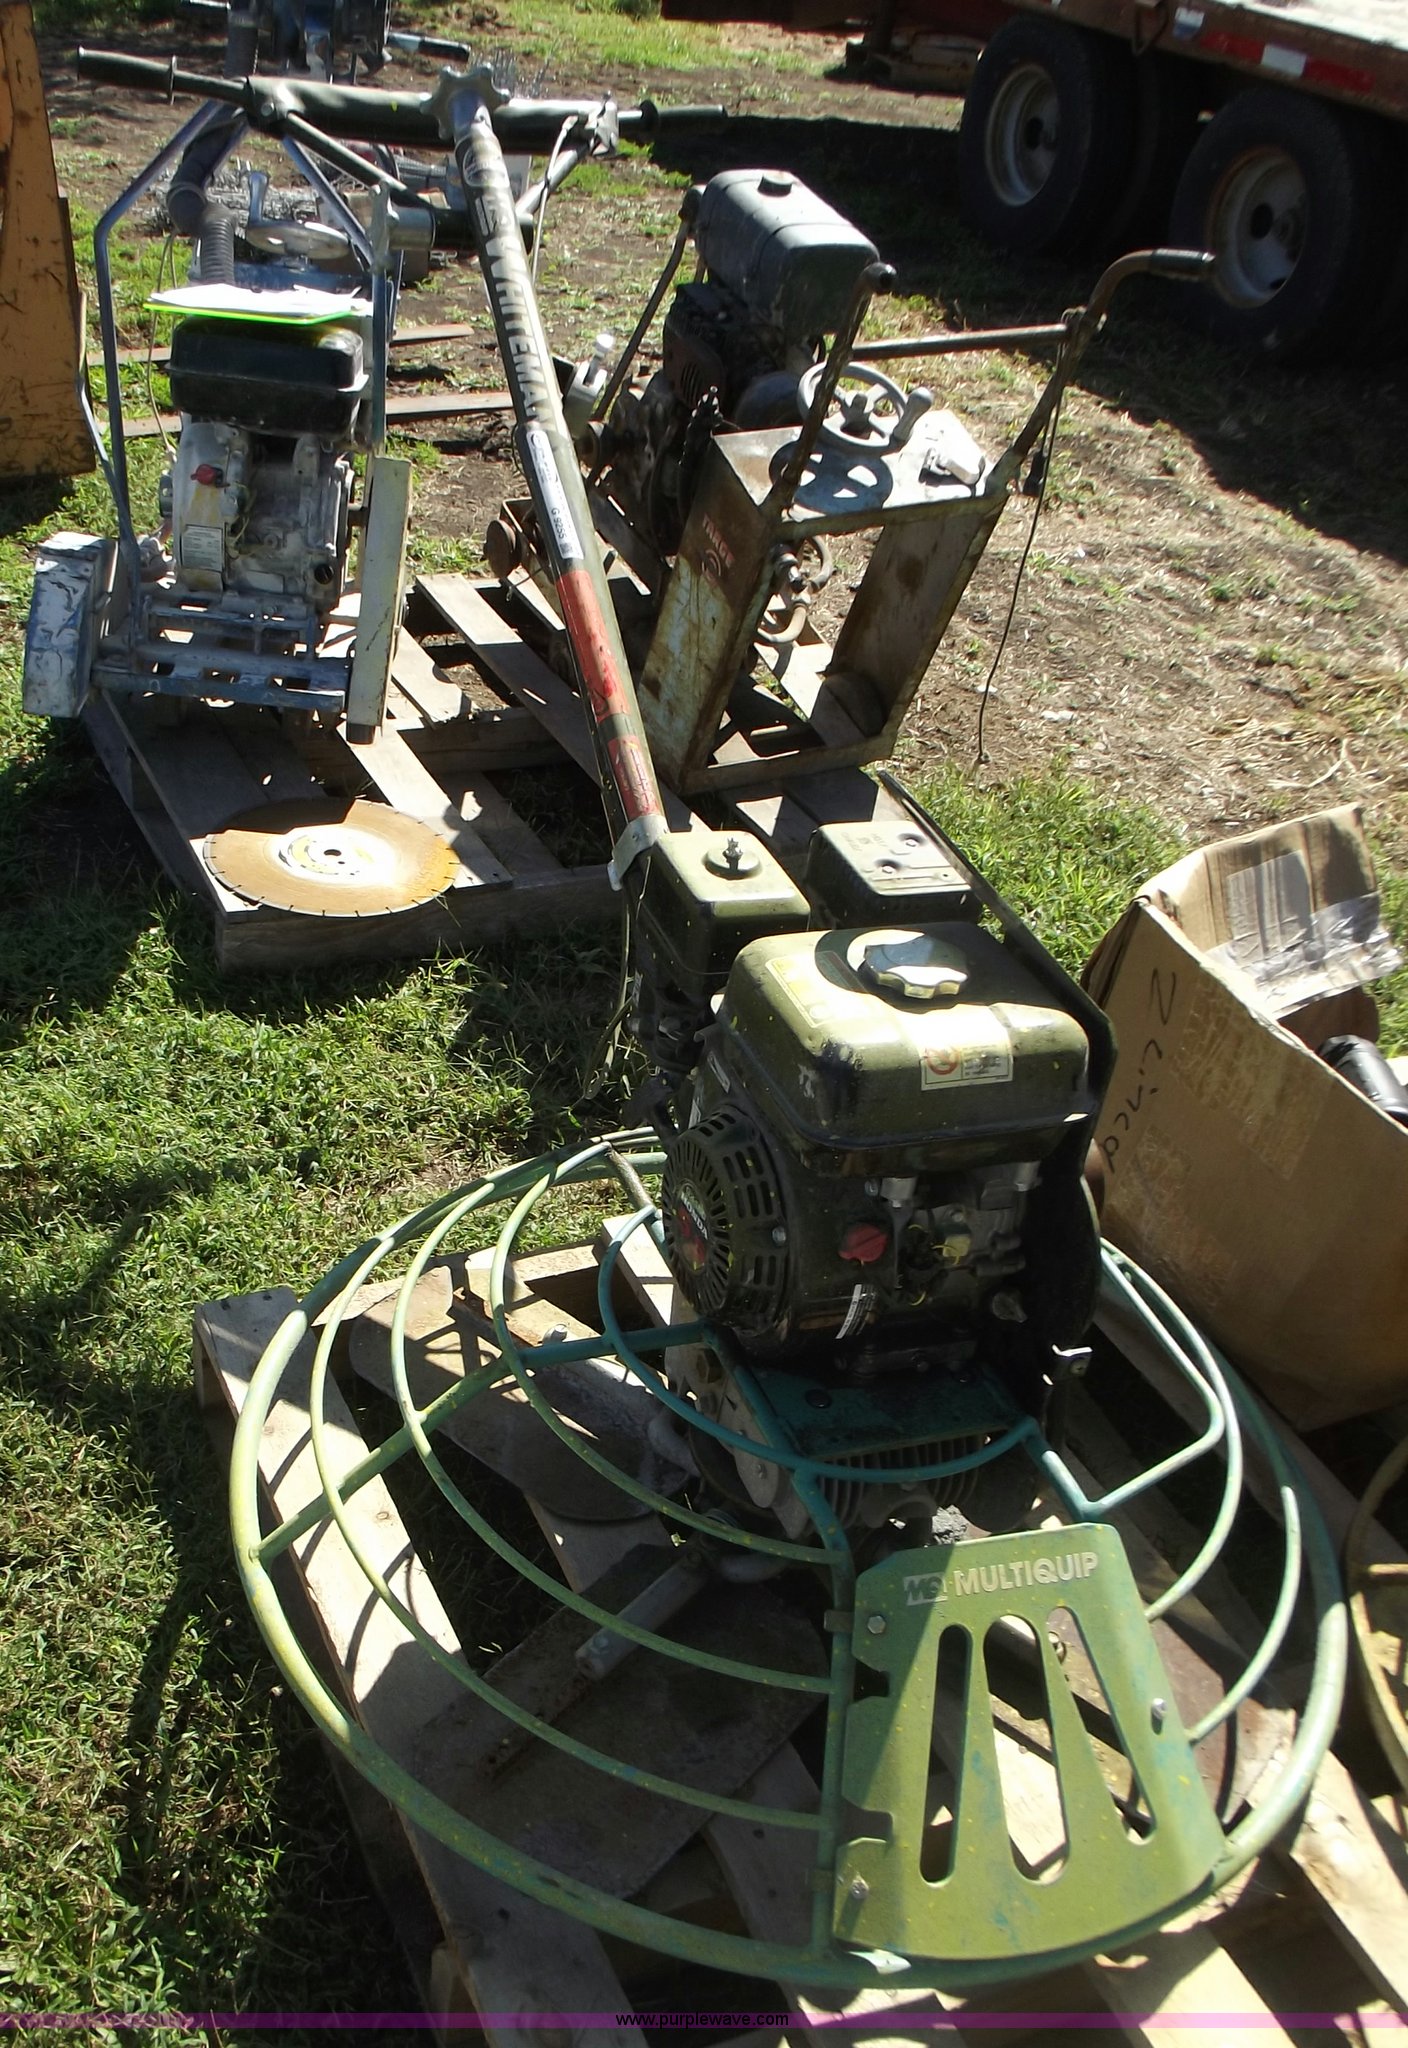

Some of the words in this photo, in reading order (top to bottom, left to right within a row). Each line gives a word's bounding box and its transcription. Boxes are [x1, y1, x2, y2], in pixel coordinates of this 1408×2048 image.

[485, 236, 557, 431] WHITEMAN
[681, 1190, 709, 1241] HONDA
[953, 1551, 1099, 1597] MULTIQUIP
